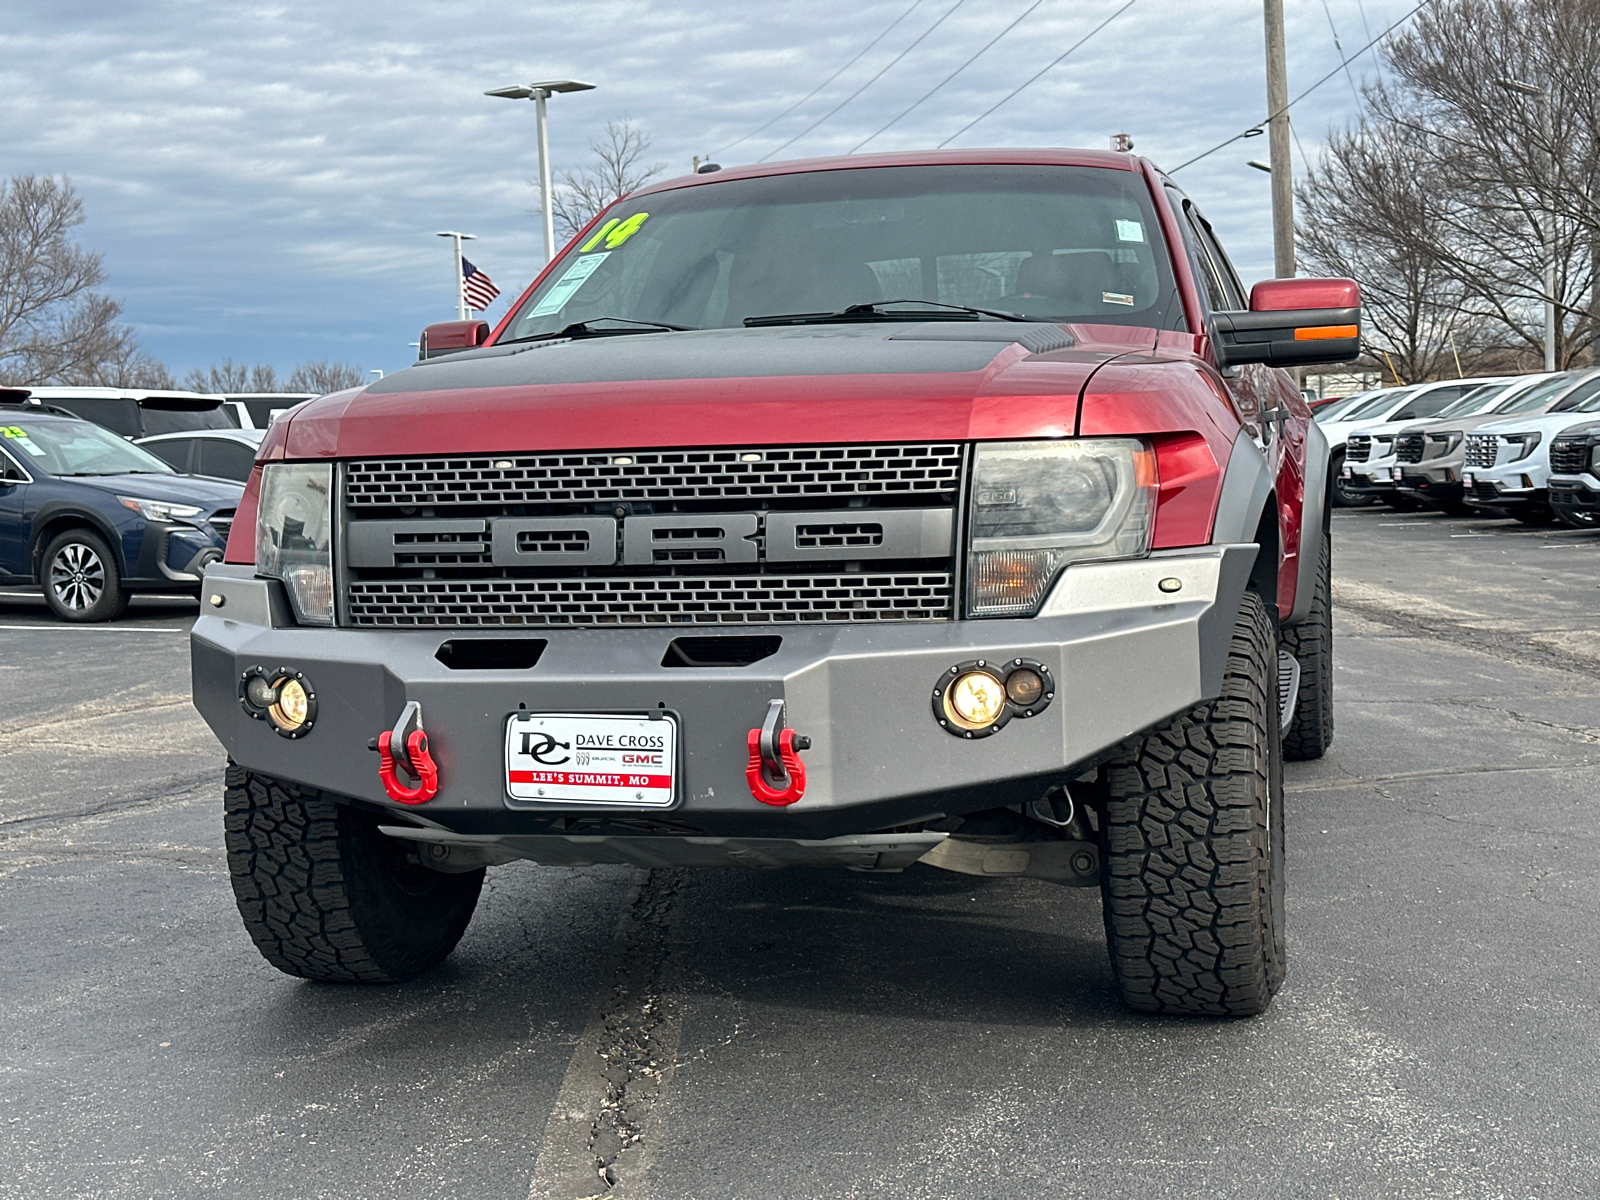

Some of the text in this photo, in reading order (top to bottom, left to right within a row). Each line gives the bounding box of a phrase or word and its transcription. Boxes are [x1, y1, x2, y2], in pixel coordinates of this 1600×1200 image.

[579, 212, 649, 253] 14
[347, 508, 954, 568] FORD
[518, 732, 571, 765] DC
[576, 734, 664, 748] DAVE CROSS
[622, 754, 663, 764] GMC
[532, 772, 649, 786] LEE'S SUMMIT, MO
